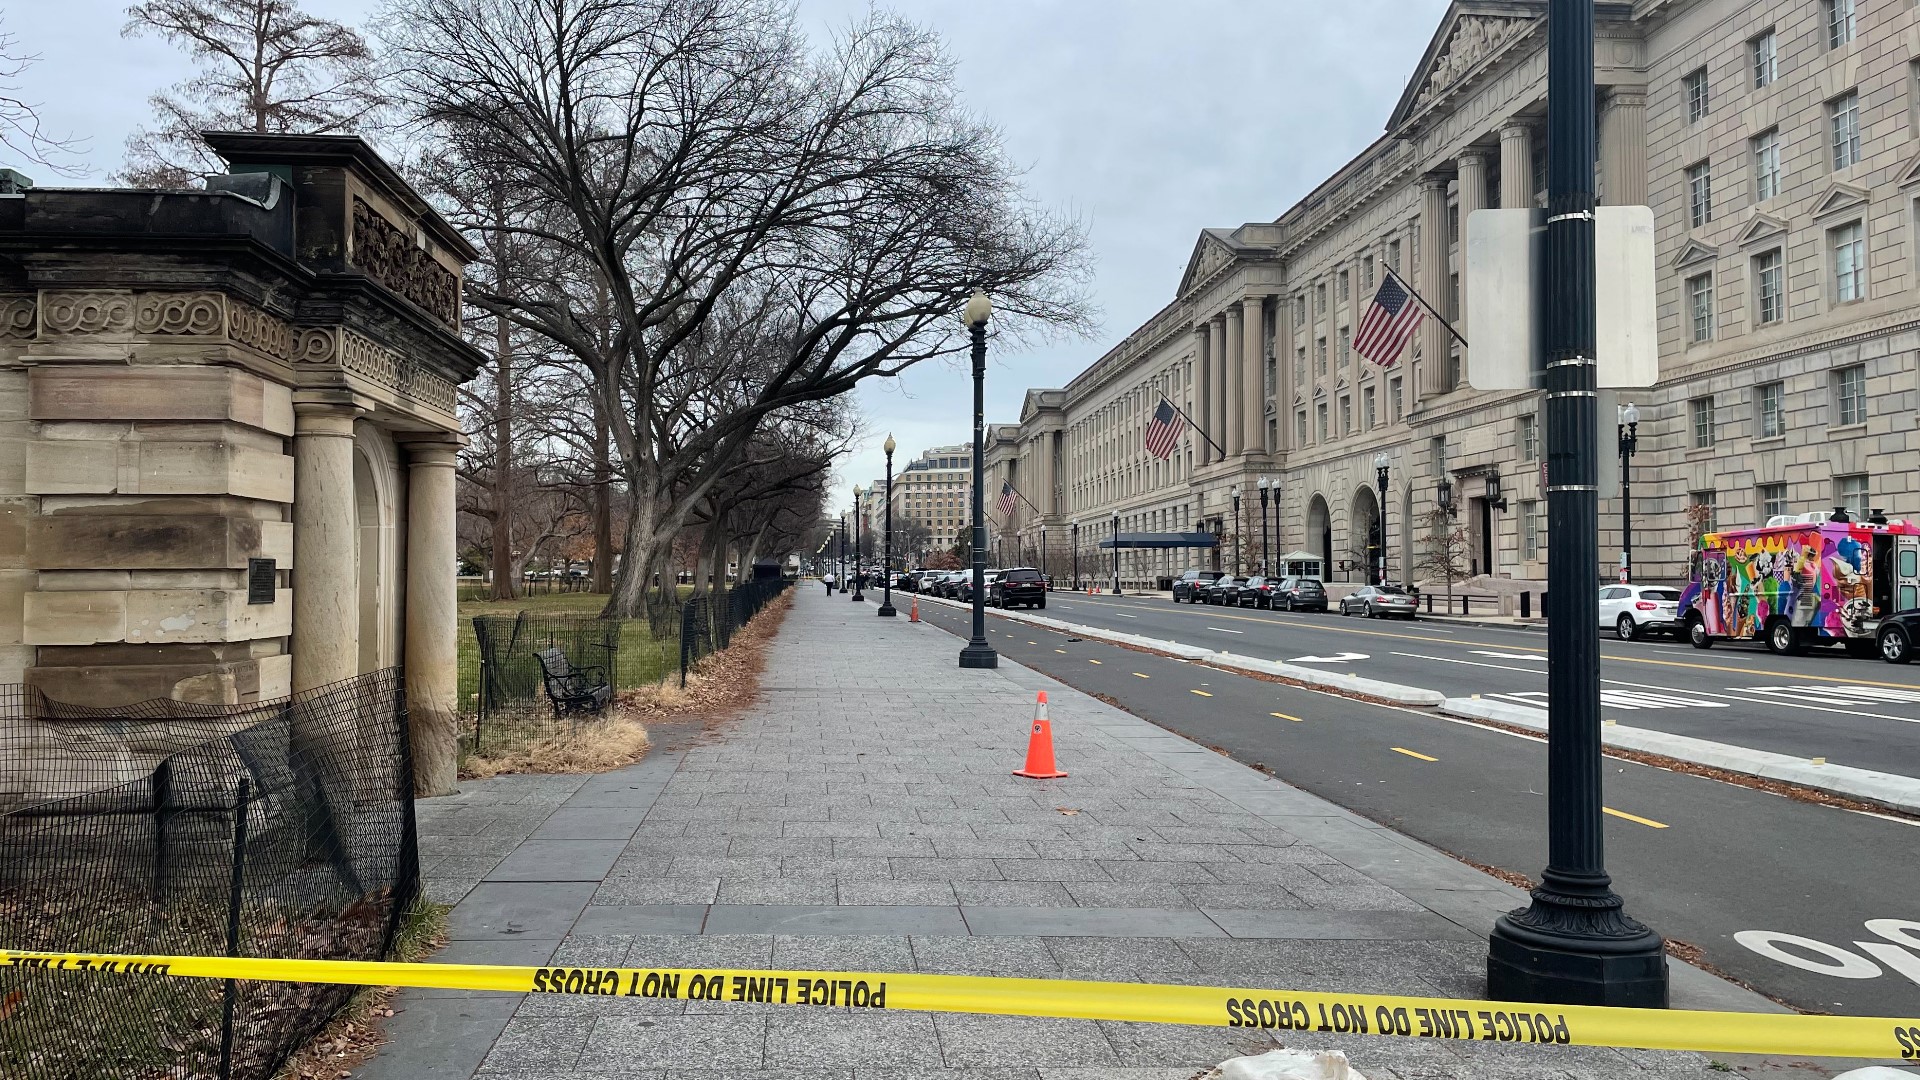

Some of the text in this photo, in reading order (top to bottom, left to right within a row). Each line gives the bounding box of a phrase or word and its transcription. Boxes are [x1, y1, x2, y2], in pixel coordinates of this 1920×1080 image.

[532, 969, 887, 1008] POLICE LINE DO NOT CROSS
[1226, 998, 1571, 1044] POLICE LINE DO NOT CROSS
